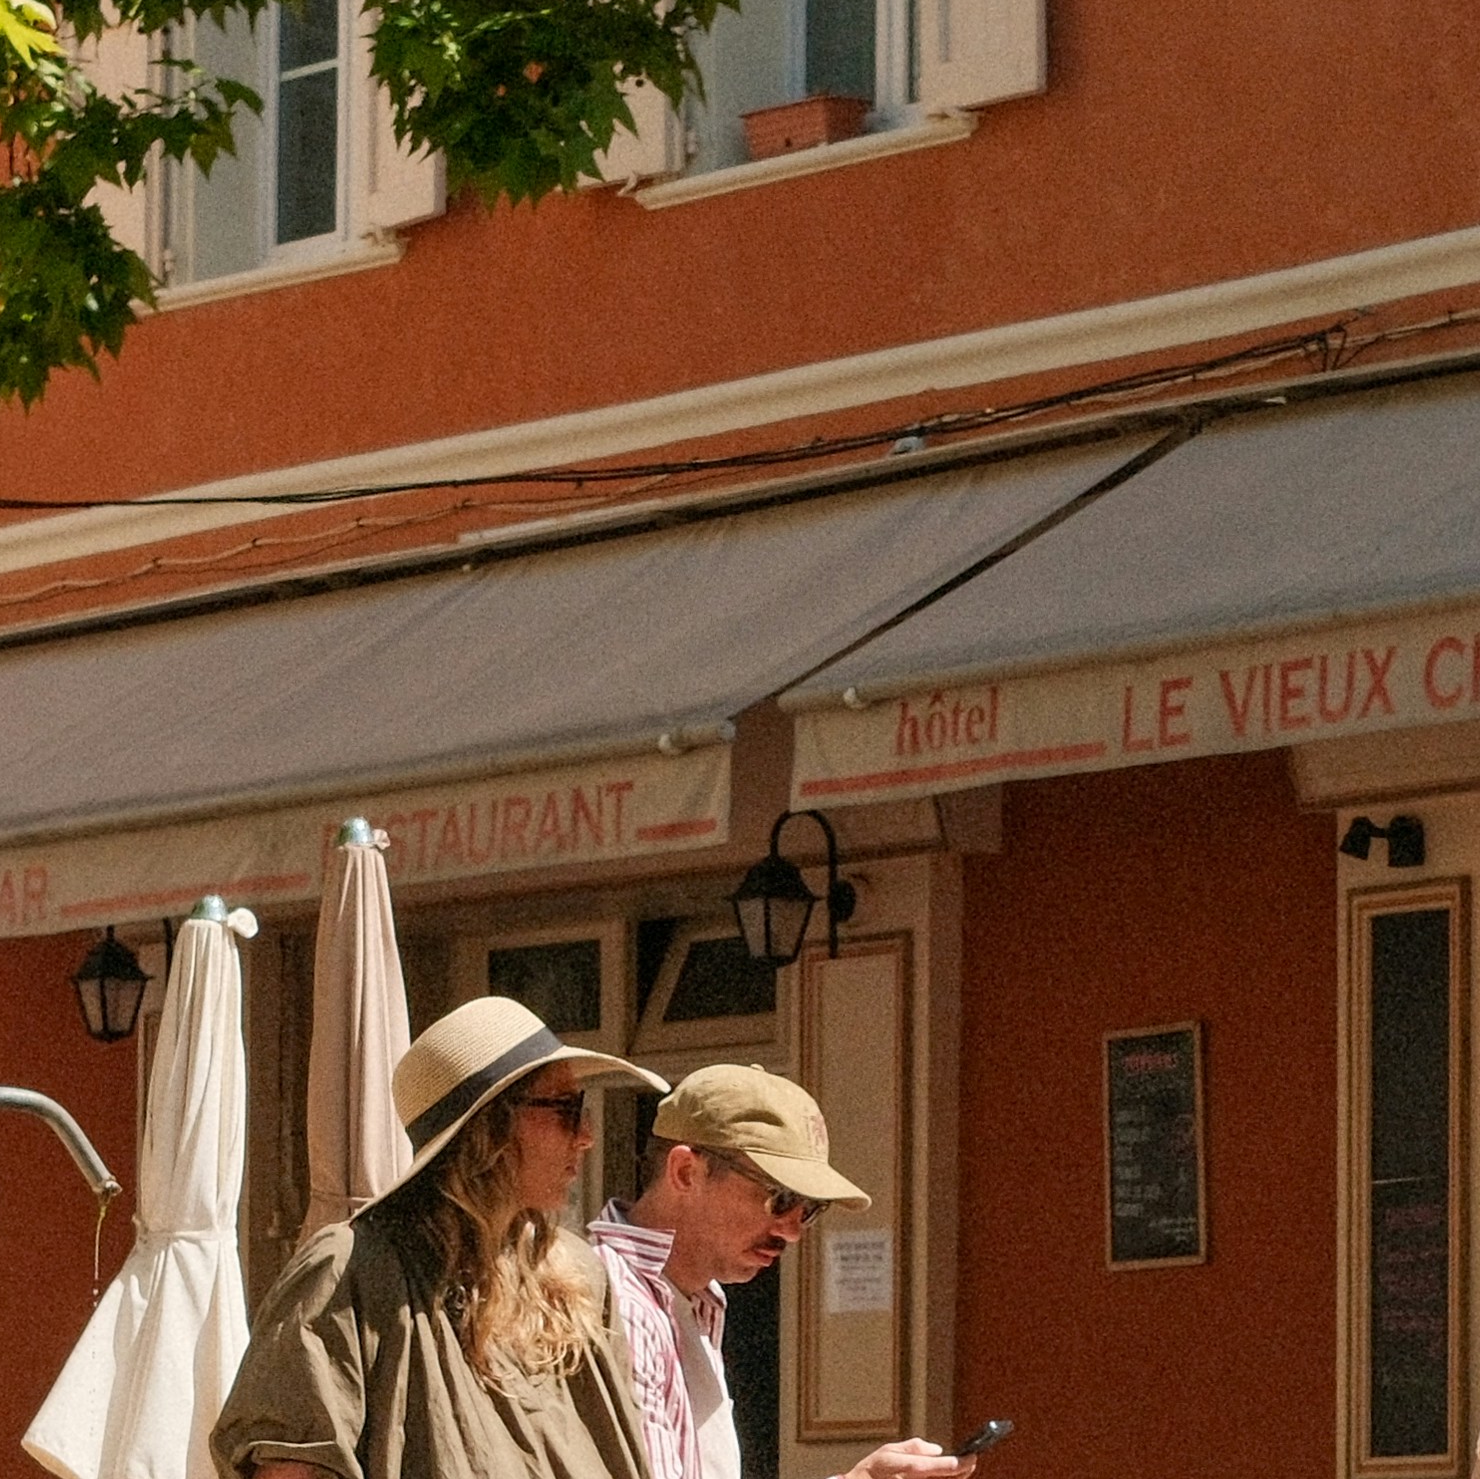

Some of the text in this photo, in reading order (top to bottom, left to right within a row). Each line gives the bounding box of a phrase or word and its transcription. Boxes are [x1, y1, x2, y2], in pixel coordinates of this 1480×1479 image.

[893, 683, 1002, 757] hôtel
[1121, 674, 1194, 752] LE
[1218, 645, 1397, 738] VIEUX
[322, 780, 634, 878] STAURANT
